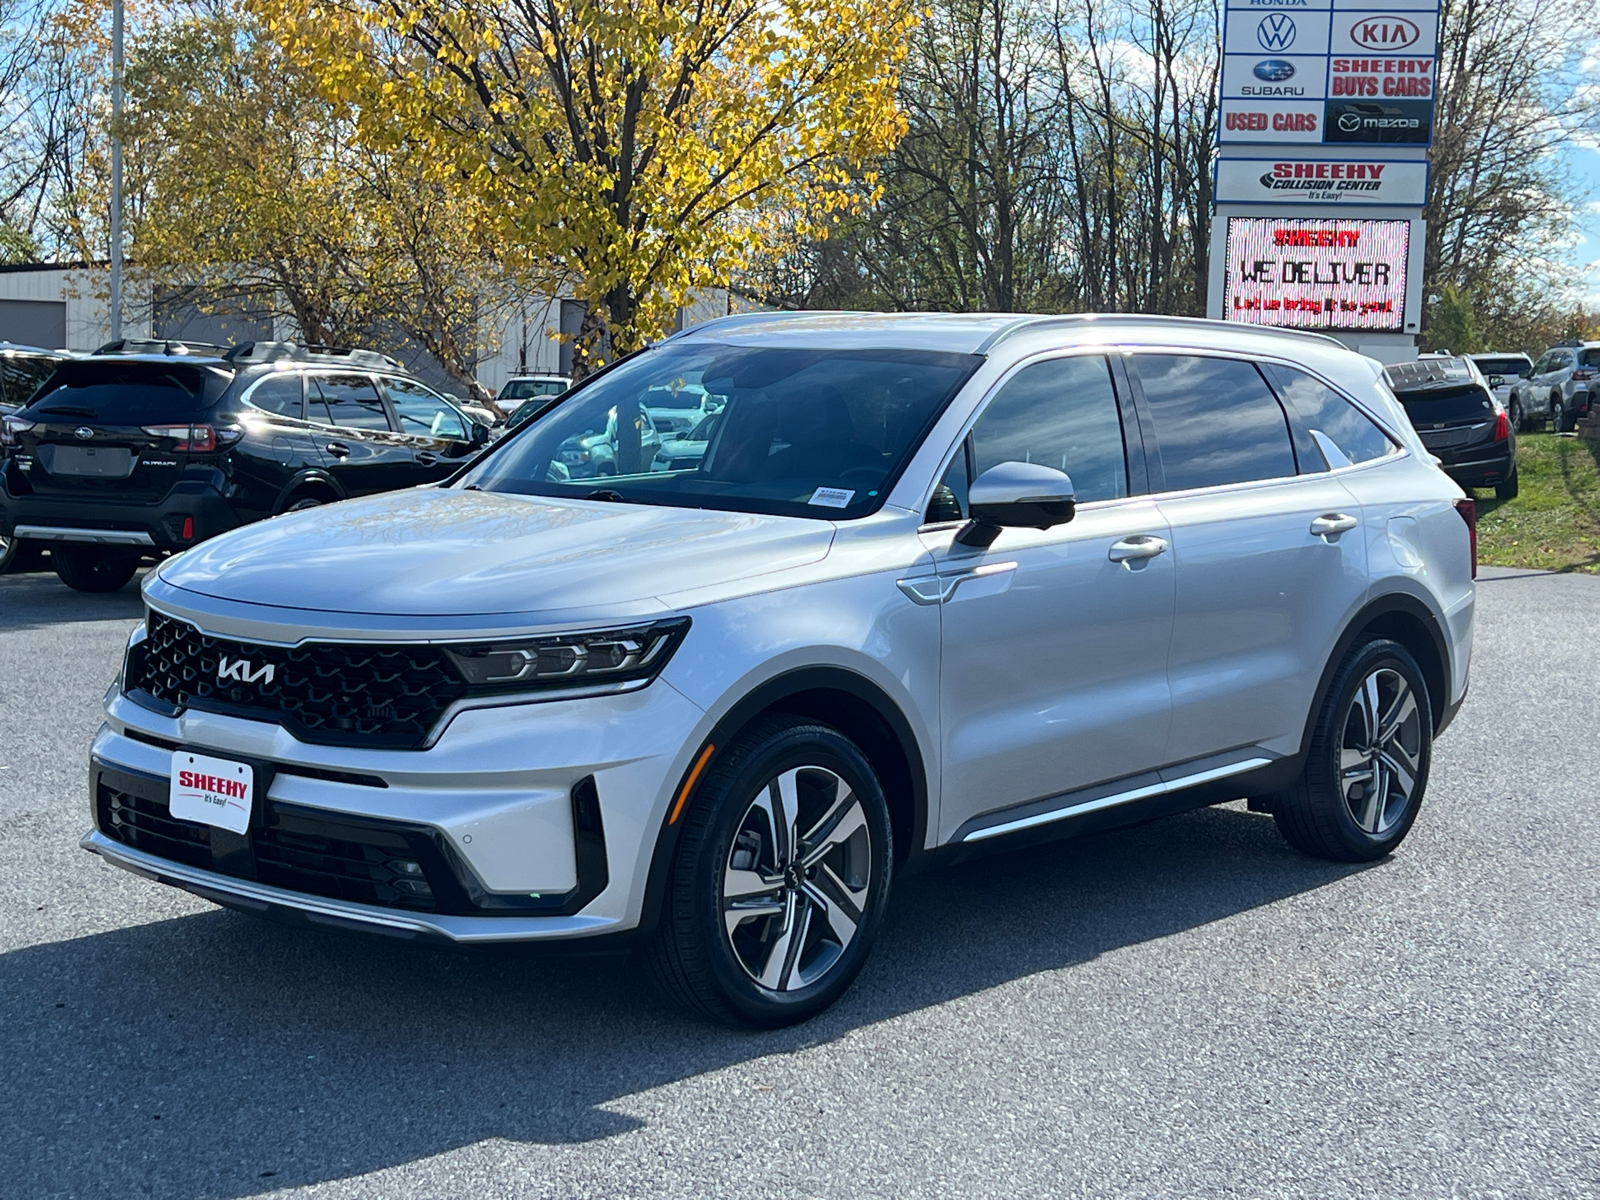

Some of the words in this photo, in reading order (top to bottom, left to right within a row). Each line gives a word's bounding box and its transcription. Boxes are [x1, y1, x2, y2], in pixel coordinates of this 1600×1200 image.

[1363, 24, 1407, 43] KIA
[1333, 59, 1432, 73] SHEEHY
[1241, 86, 1304, 96] SUBARU
[1332, 76, 1378, 96] BUYS
[1383, 77, 1431, 97] CARS
[1226, 112, 1268, 131] USED
[1273, 113, 1317, 132] CARS
[1364, 118, 1419, 129] mazda
[1273, 163, 1385, 179] SHEEHY
[1272, 179, 1334, 190] COLLISION
[1336, 180, 1382, 191] CENTER
[1308, 191, 1319, 200] It's
[1321, 191, 1343, 201] Easy!
[1240, 261, 1275, 283] WE
[1282, 261, 1390, 285] DELIVER
[218, 657, 275, 685] KIA
[179, 770, 247, 800] SHEEHY
[204, 793, 212, 803] It's
